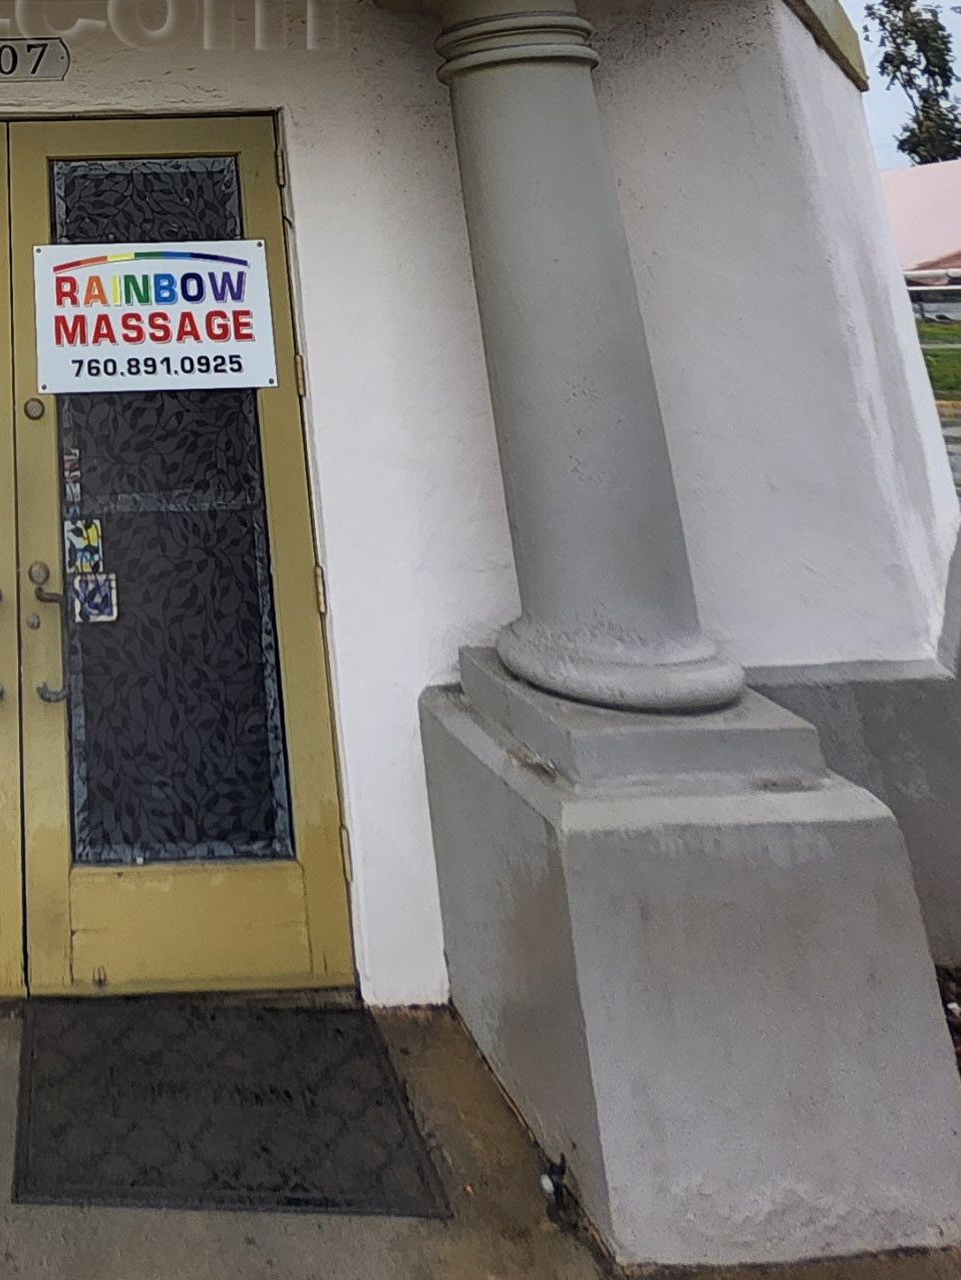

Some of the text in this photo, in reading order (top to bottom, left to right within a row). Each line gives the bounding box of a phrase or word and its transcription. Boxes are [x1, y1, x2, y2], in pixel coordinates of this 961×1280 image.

[54, 270, 249, 307] RAINBOW
[53, 309, 256, 346] MASSAGE
[71, 354, 244, 378] 760.891.0925
